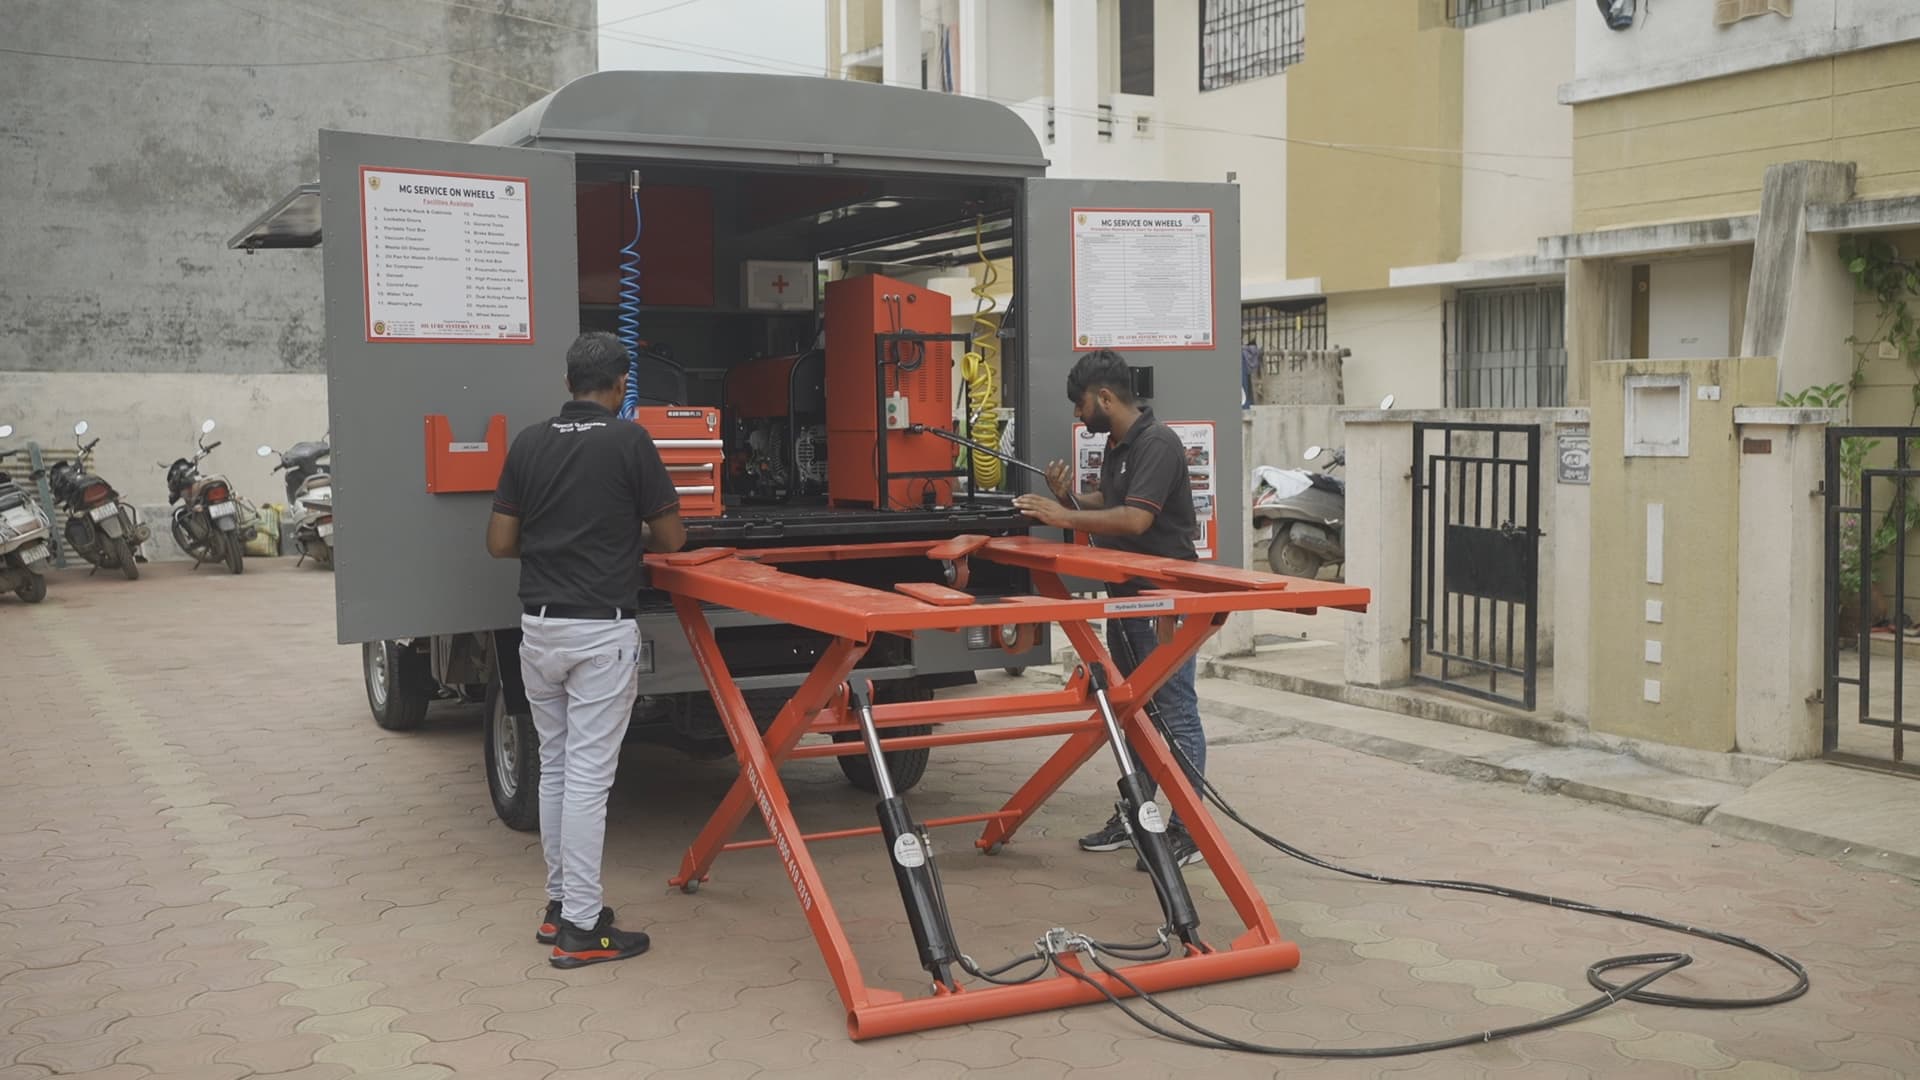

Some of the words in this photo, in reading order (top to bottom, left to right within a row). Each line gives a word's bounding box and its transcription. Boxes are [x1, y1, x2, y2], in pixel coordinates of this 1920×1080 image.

[399, 184, 412, 194] MG
[414, 185, 448, 196] SERVICE
[449, 187, 462, 197] ON
[463, 188, 496, 200] WHEELS
[1101, 219, 1112, 227] MG
[1113, 219, 1141, 227] SERVICE
[1142, 219, 1153, 227] ON
[1154, 219, 1183, 228] WHEELS
[747, 761, 759, 795] TOLL
[757, 789, 773, 819] FREE
